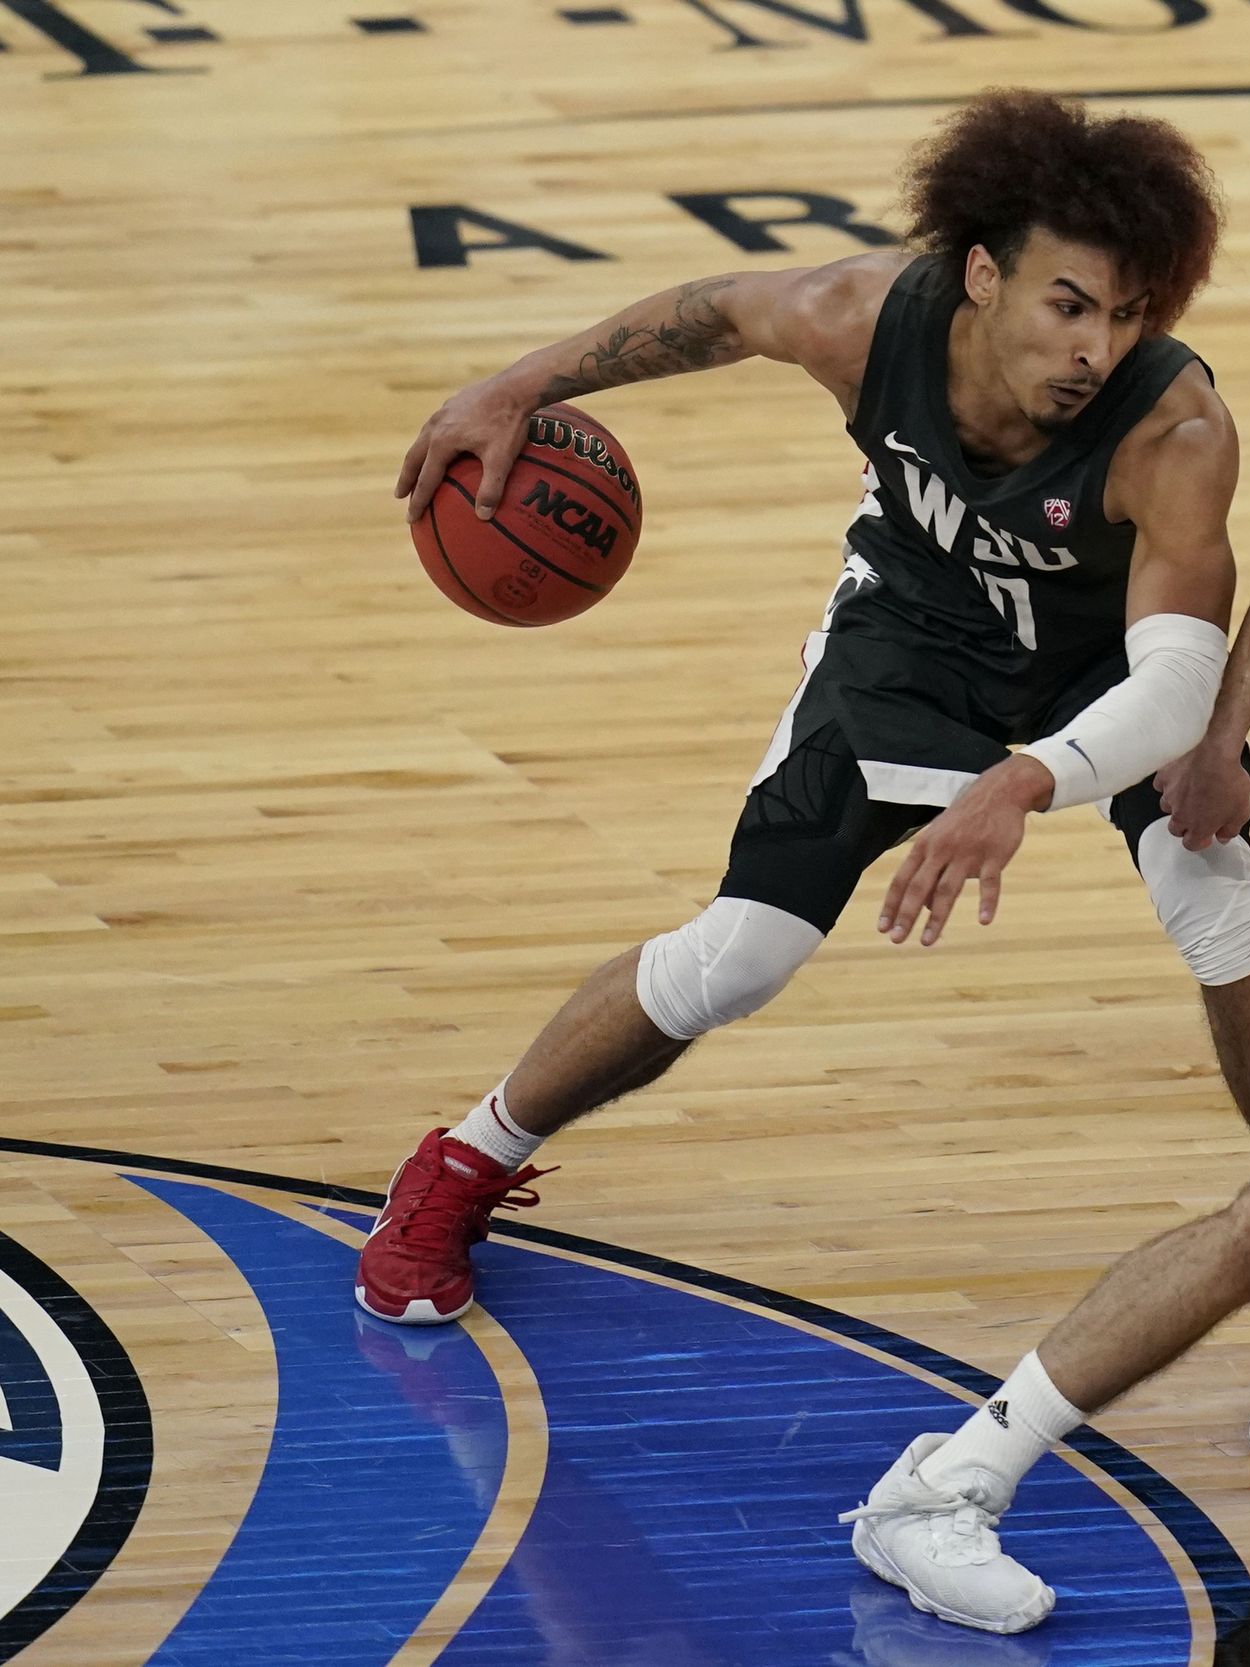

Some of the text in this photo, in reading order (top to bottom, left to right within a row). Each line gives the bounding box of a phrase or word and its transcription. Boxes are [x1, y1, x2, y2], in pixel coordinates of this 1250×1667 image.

[521, 479, 618, 558] NCAA
[898, 457, 1080, 572] WSU
[1050, 513, 1065, 527] 12
